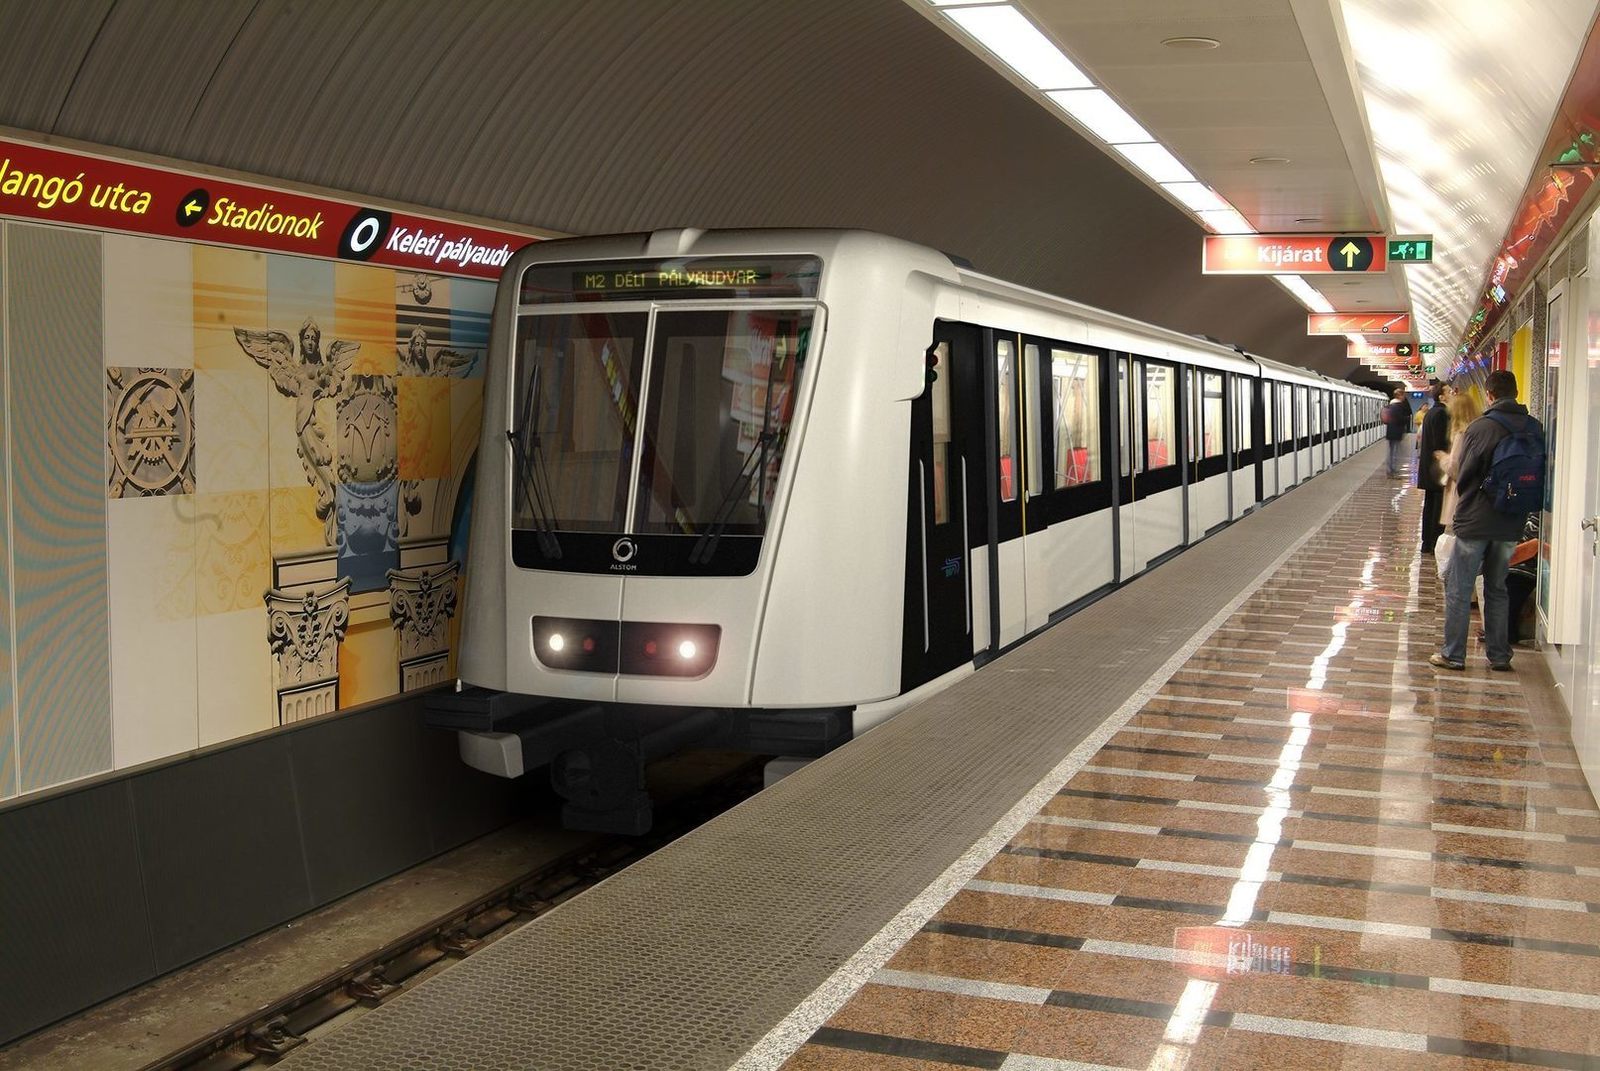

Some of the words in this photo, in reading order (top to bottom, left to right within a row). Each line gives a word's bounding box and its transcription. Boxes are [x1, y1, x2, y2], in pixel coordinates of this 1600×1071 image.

[90, 183, 152, 214] utca
[208, 197, 324, 239] Stadionok
[386, 226, 444, 256] Keleti
[1257, 245, 1322, 266] Kijárat
[585, 273, 605, 289] M2
[659, 269, 757, 287] PÁLYAUDVAR
